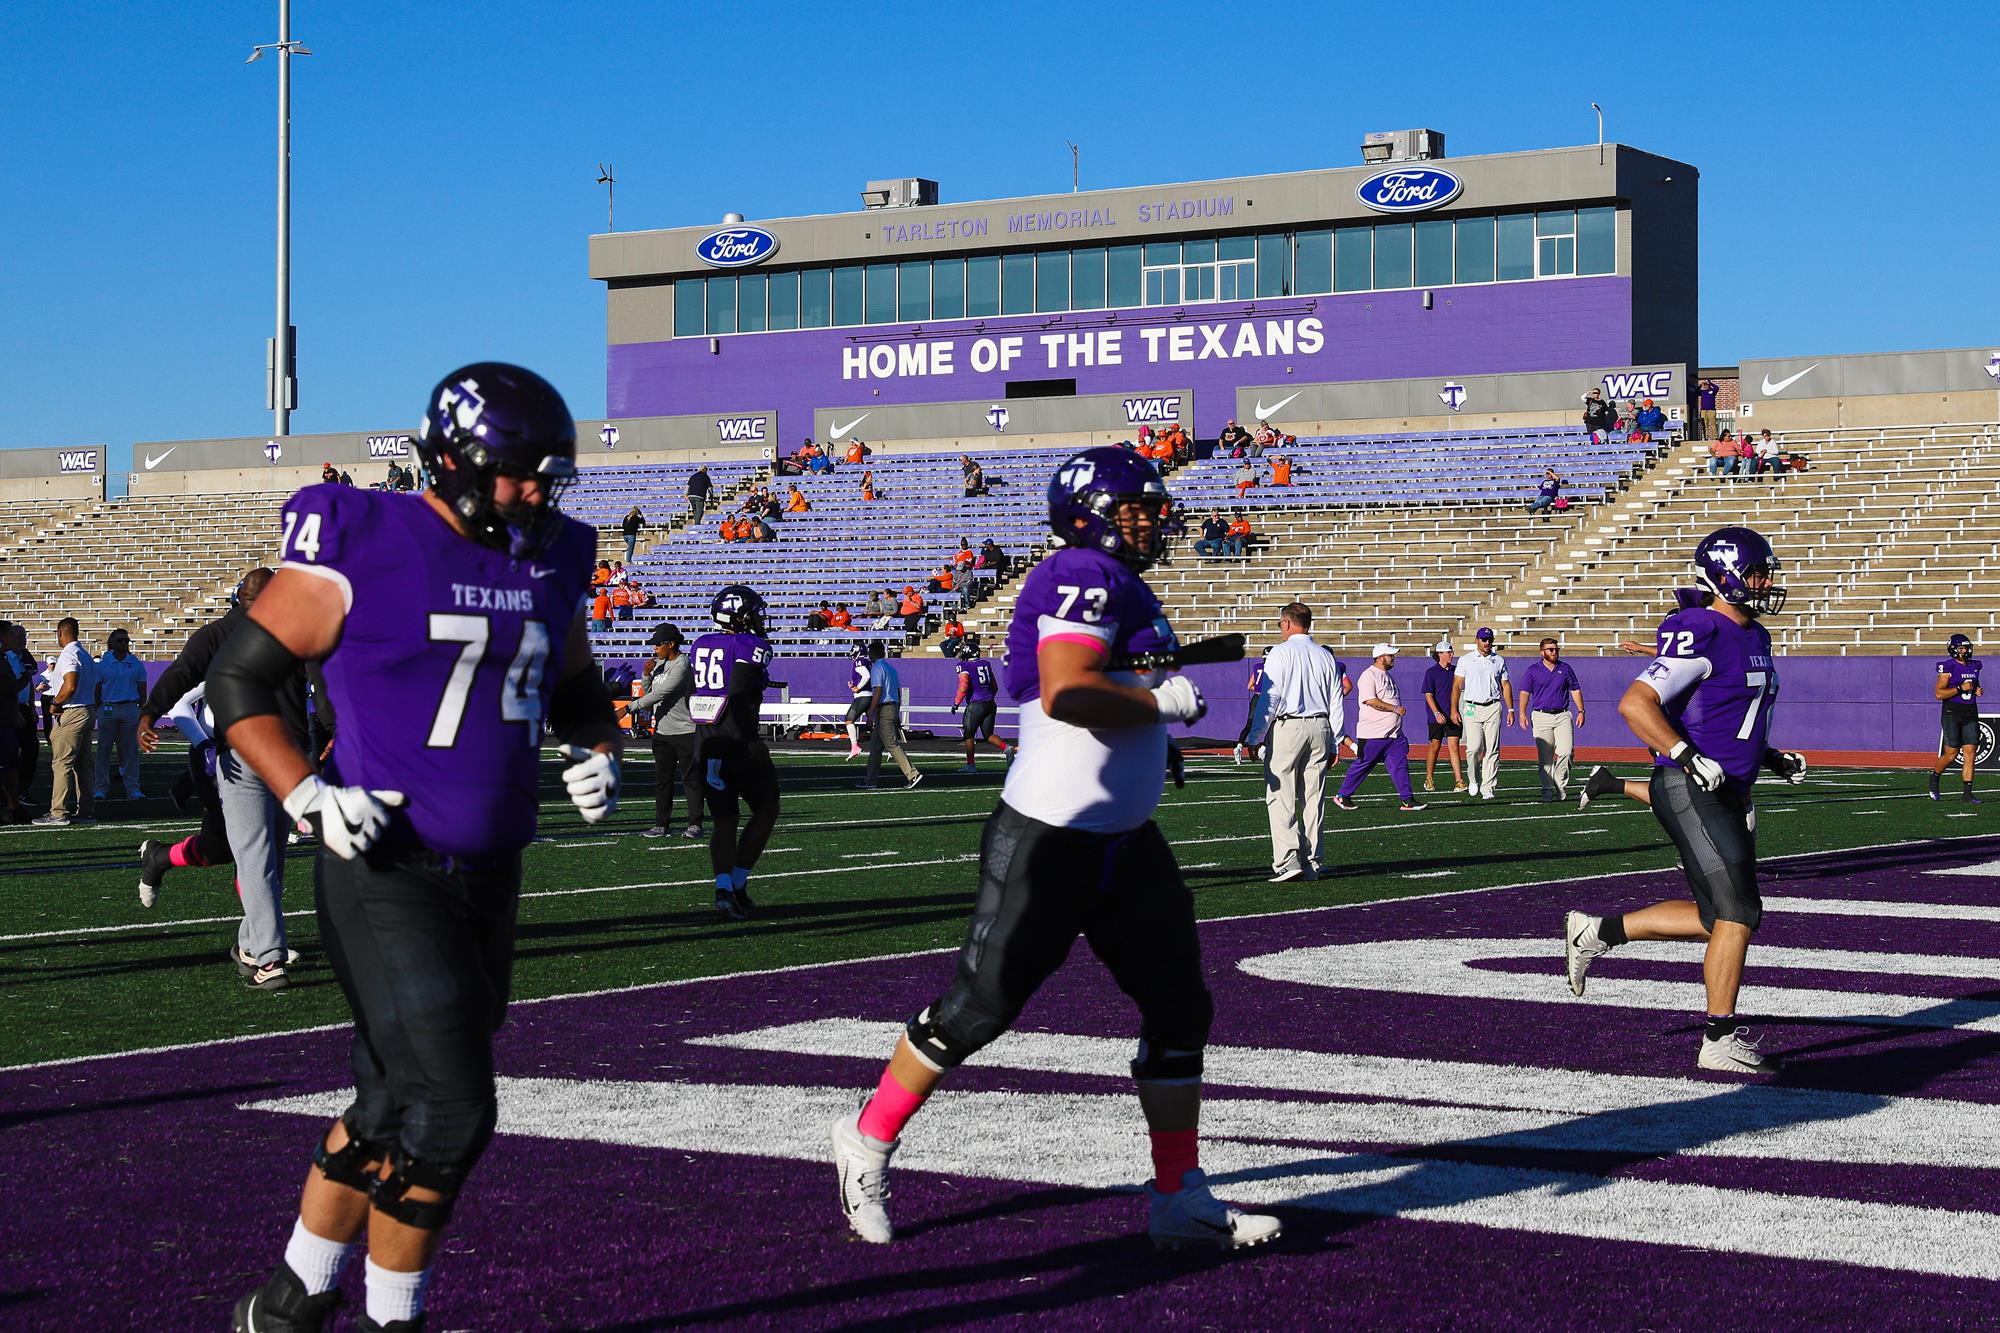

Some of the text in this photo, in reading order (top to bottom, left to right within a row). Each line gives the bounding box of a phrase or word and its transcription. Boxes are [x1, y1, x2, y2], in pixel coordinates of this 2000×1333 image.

[1377, 173, 1439, 203] Ford
[883, 197, 1235, 243] TARLETON MEMORIAL STADIUM
[711, 232, 760, 259] Ford
[842, 317, 1325, 380] HOME OF THE TEXANS
[1602, 371, 1672, 399] WAC
[1123, 396, 1180, 422] WAC
[717, 417, 767, 441] WAC
[367, 435, 410, 456] WAC
[58, 451, 97, 471] WAC
[280, 511, 322, 561] 74
[451, 583, 534, 612] TEXANS
[1055, 585, 1108, 622] 73
[752, 647, 772, 665] 56
[1660, 630, 1695, 656] 72
[694, 648, 725, 690] 56
[977, 665, 991, 684] 51
[1749, 655, 1773, 667] TEXA
[1938, 664, 1944, 673] 3
[424, 613, 551, 748] 74
